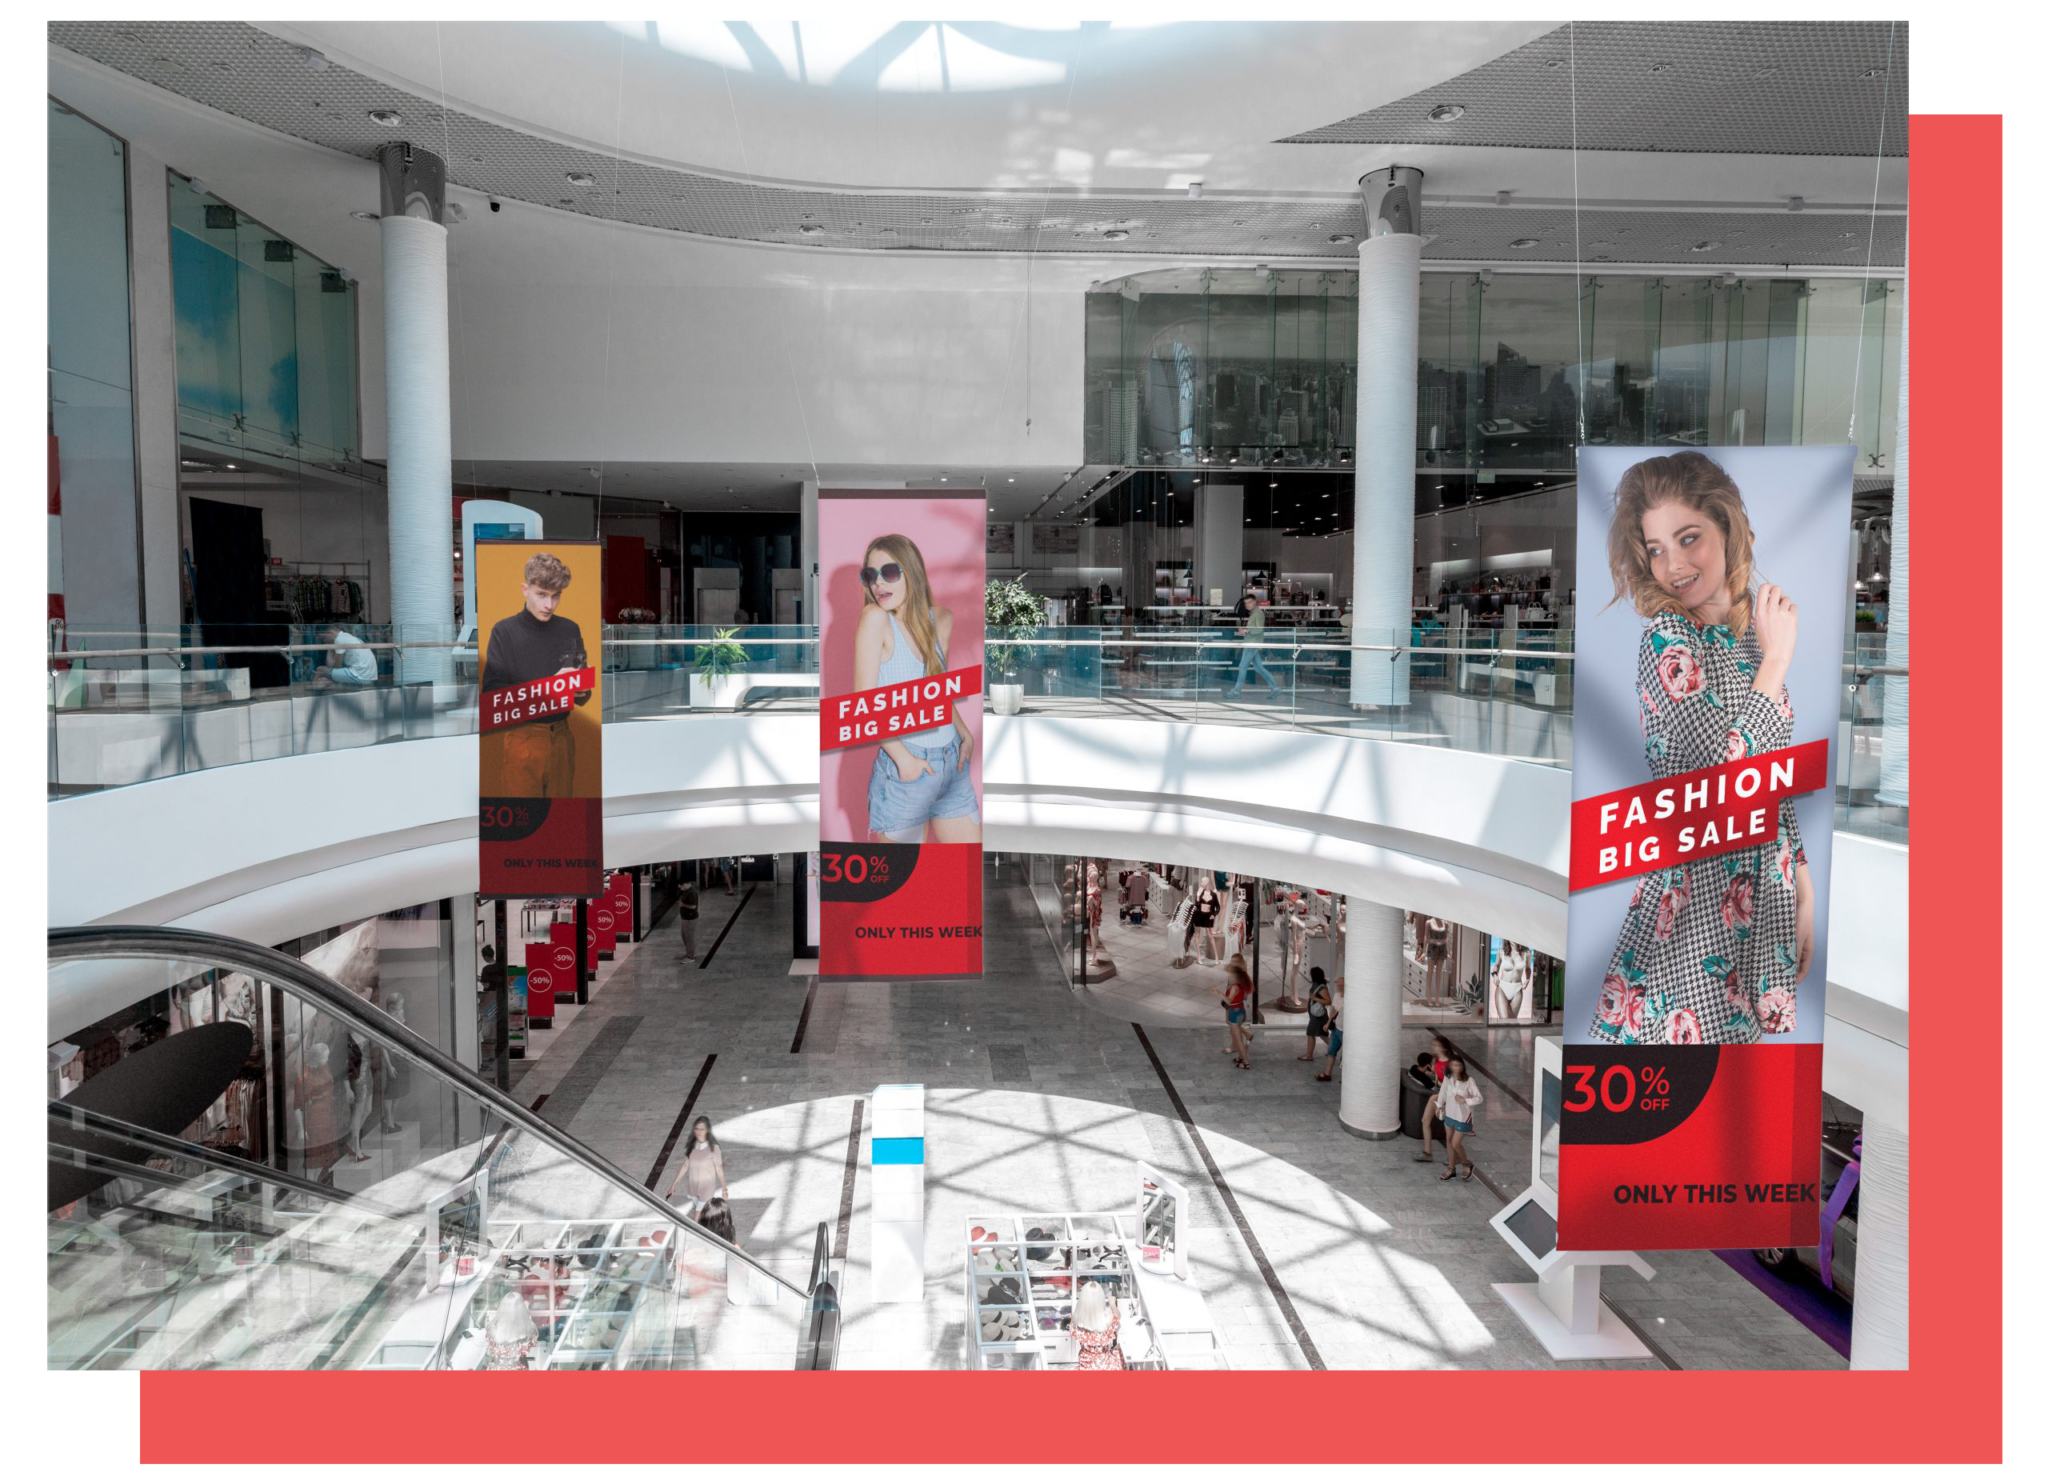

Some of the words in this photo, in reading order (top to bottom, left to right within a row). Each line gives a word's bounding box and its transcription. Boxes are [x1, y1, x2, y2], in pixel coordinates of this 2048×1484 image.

[494, 674, 581, 707] FASHION
[839, 675, 961, 719] FASHION
[494, 710, 521, 724] BIG
[528, 696, 569, 715] SALE
[839, 720, 878, 742] BIG
[888, 705, 945, 731] SALE
[1599, 758, 1796, 836] FASHION
[1599, 837, 1661, 873] BIG
[1677, 808, 1767, 853] SALE
[503, 858, 533, 868] ONLY
[536, 858, 562, 868] THIS
[565, 858, 599, 868] WEEK
[870, 875, 890, 883] OFF
[855, 926, 895, 939] ONLY
[899, 926, 934, 939] THIS
[938, 925, 983, 938] WEEK
[554, 954, 573, 962] -50%
[530, 976, 550, 984] -50%
[1640, 1098, 1670, 1111] OFF
[1613, 1184, 1677, 1205] ONLY
[1683, 1184, 1738, 1204] THIS
[1744, 1183, 1816, 1203] WEEK
